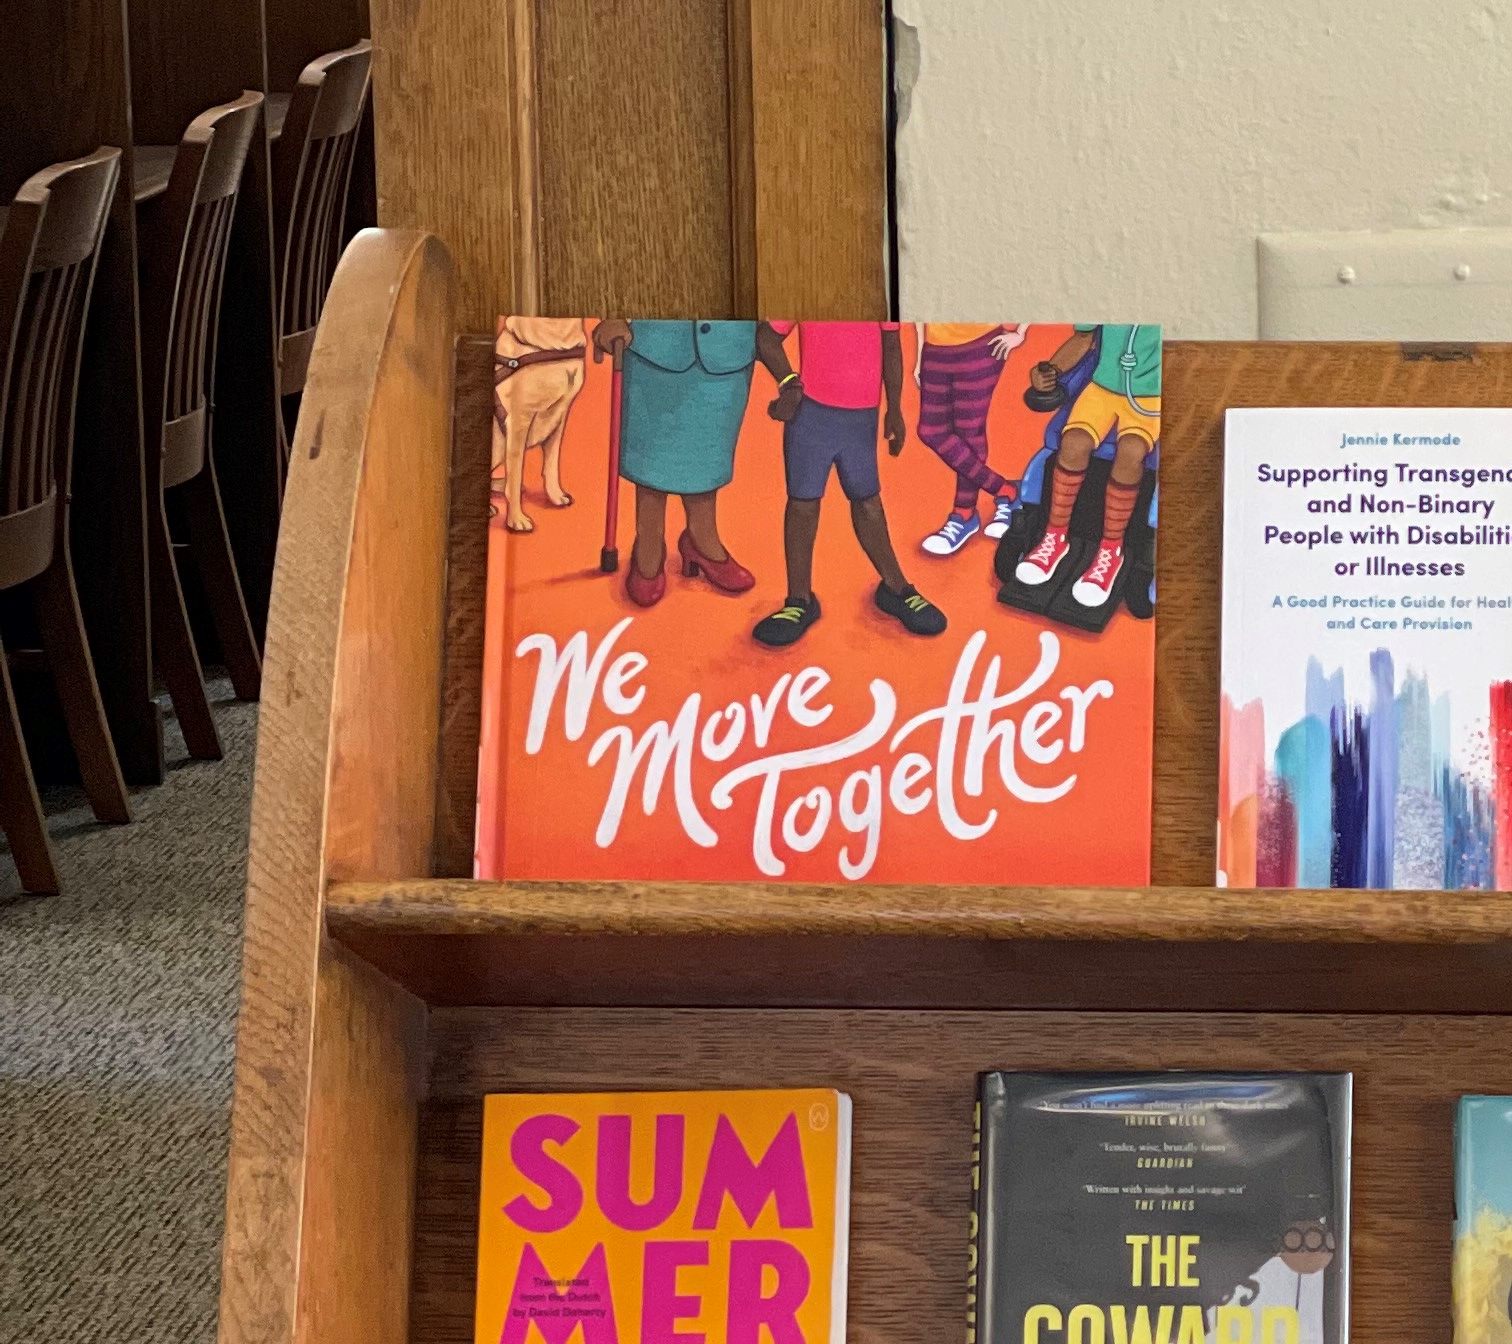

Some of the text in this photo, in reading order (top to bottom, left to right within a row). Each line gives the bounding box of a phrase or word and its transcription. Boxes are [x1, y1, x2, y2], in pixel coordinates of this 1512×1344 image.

[1340, 433, 1461, 449] Jennie Kermode
[1257, 463, 1388, 488] Supporting
[1307, 494, 1495, 519] and Non-Binary
[1265, 525, 1343, 549] People
[1349, 525, 1400, 545] with
[1334, 557, 1466, 576] or Illnesses
[1272, 596, 1284, 608] A
[1287, 596, 1328, 609] Good
[1333, 596, 1397, 609] Practice
[1401, 596, 1446, 609] Guide
[1450, 595, 1473, 609] for
[1327, 617, 1473, 631] and Care Provision
[517, 618, 648, 755] We
[588, 667, 833, 848] Move
[711, 631, 1113, 880] Together
[503, 1112, 813, 1233] SUM
[1126, 1235, 1200, 1287] THE
